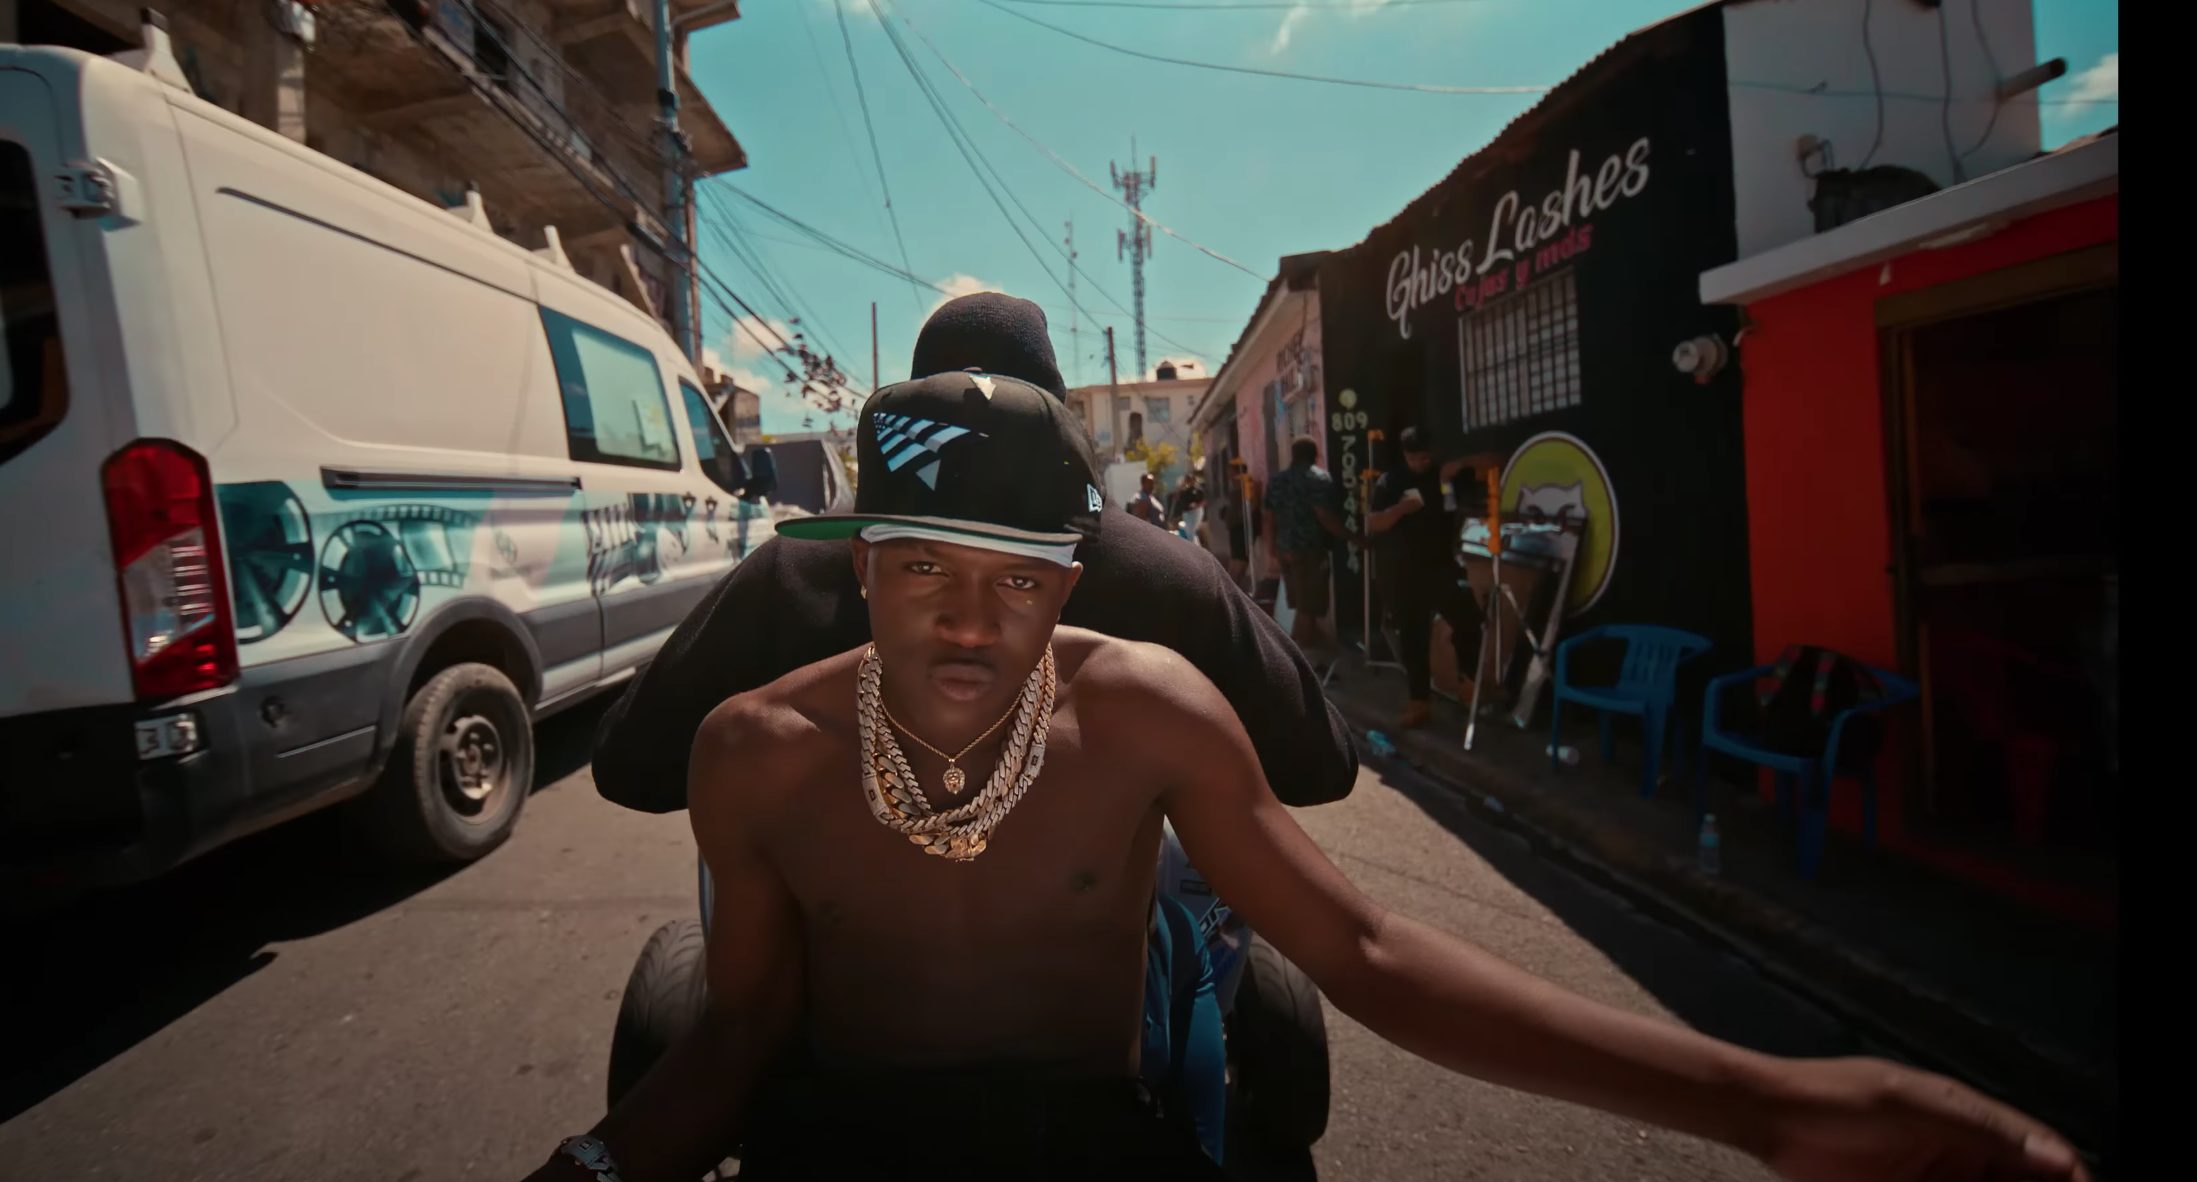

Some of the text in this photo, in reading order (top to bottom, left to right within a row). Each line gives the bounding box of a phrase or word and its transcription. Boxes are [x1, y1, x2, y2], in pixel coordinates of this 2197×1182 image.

[1386, 137, 1650, 339] Ghiss Lashes
[1515, 256, 1531, 291] y
[1331, 411, 1368, 432] 809
